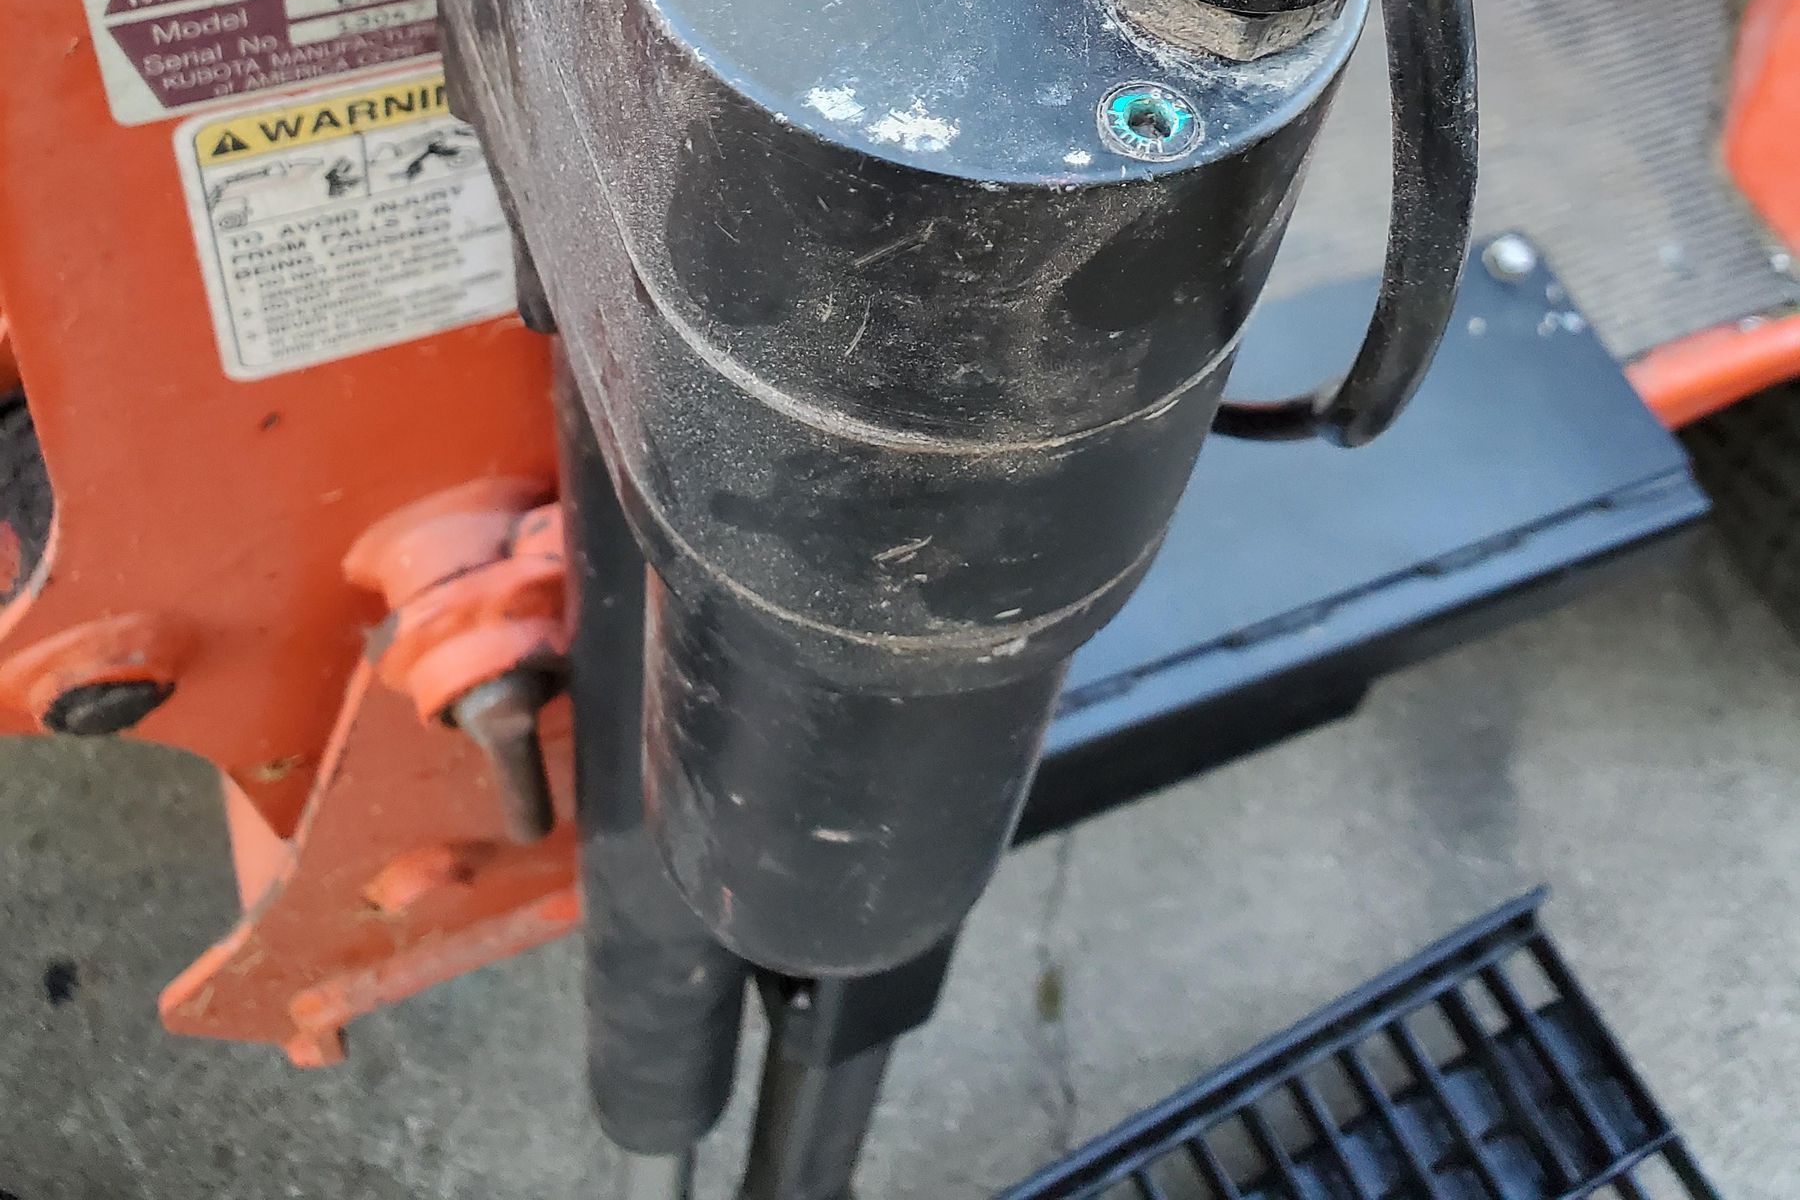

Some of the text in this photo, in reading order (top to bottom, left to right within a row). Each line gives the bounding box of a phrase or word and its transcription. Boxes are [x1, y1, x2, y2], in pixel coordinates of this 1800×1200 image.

[152, 7, 248, 46] Model
[142, 42, 223, 77] Serial
[162, 57, 260, 90] KUBOTA
